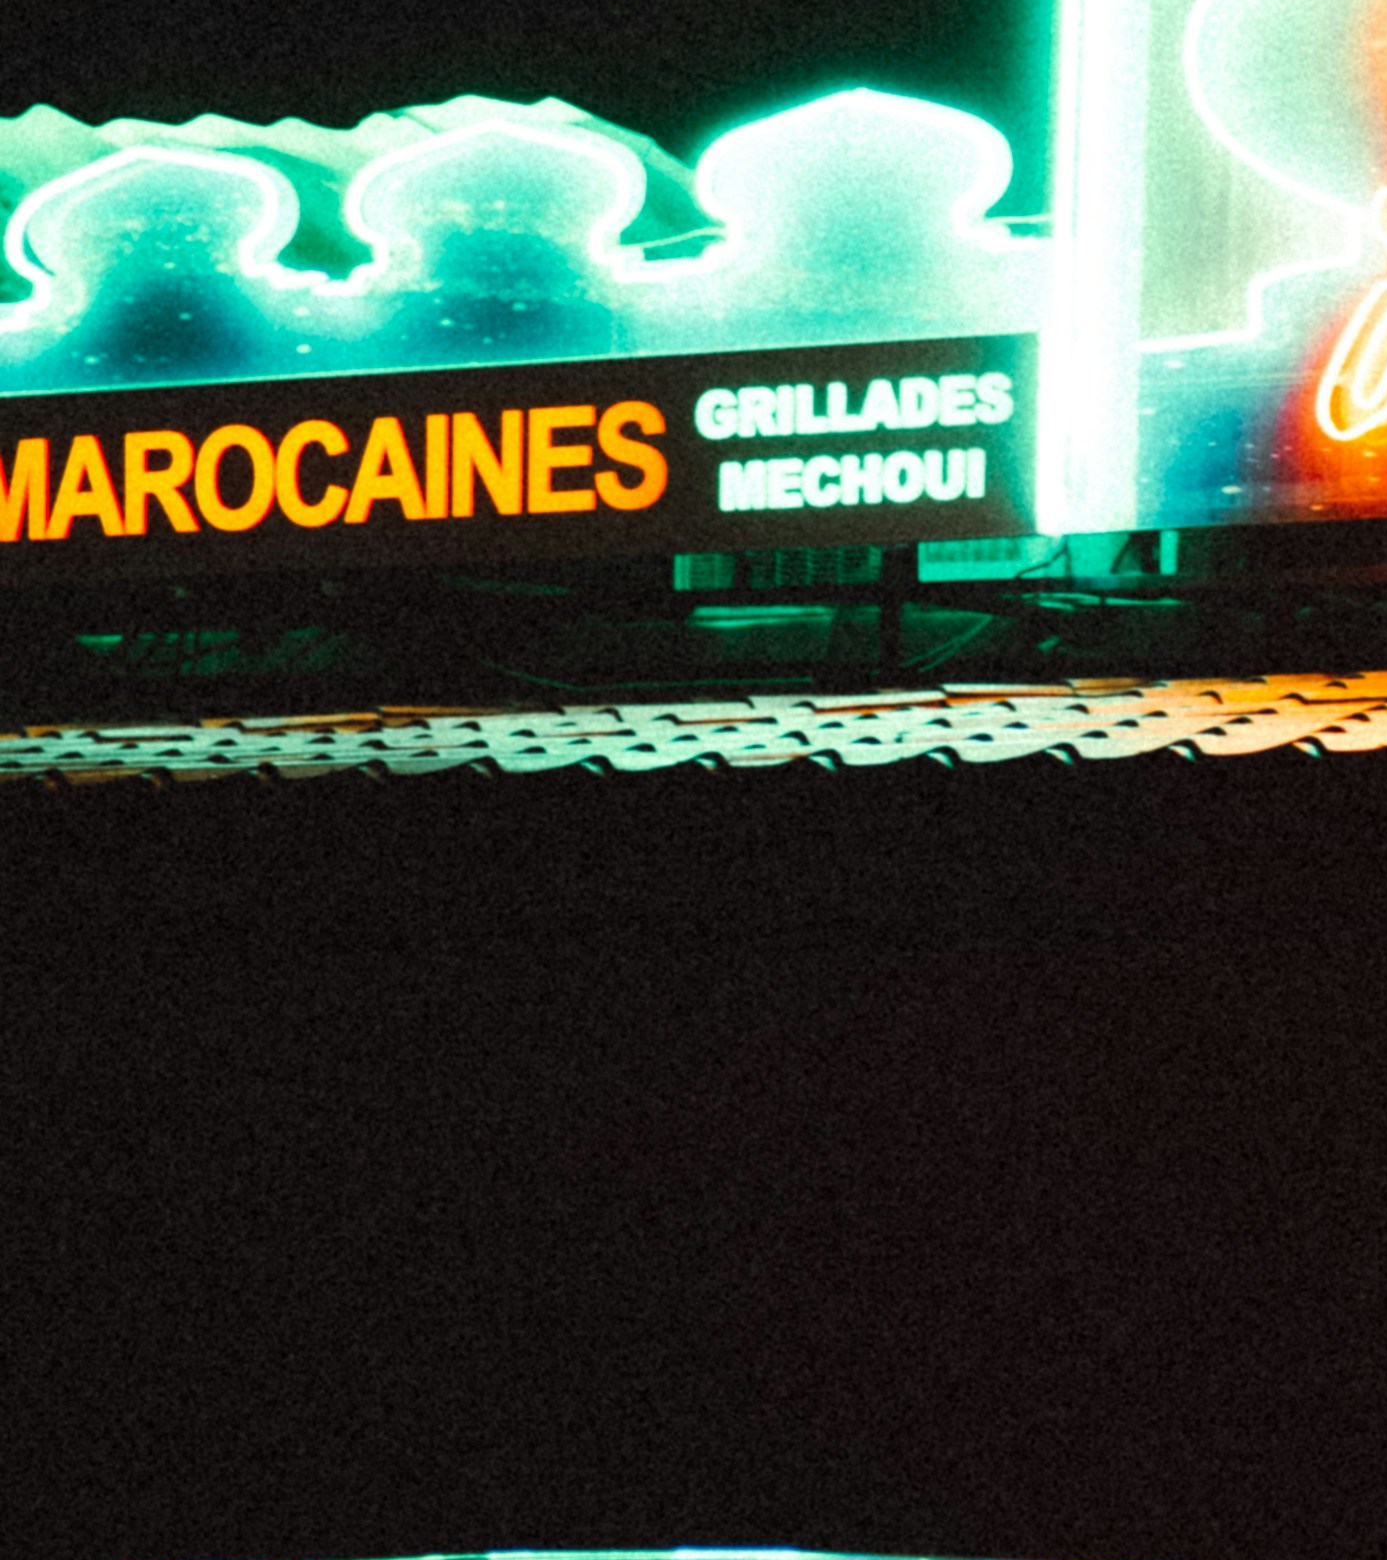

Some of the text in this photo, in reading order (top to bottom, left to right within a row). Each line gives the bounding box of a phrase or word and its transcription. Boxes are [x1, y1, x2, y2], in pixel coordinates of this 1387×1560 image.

[694, 371, 1015, 440] GRILLADES
[0, 400, 668, 543] MAROCAINES
[718, 447, 987, 512] MECHOUI
